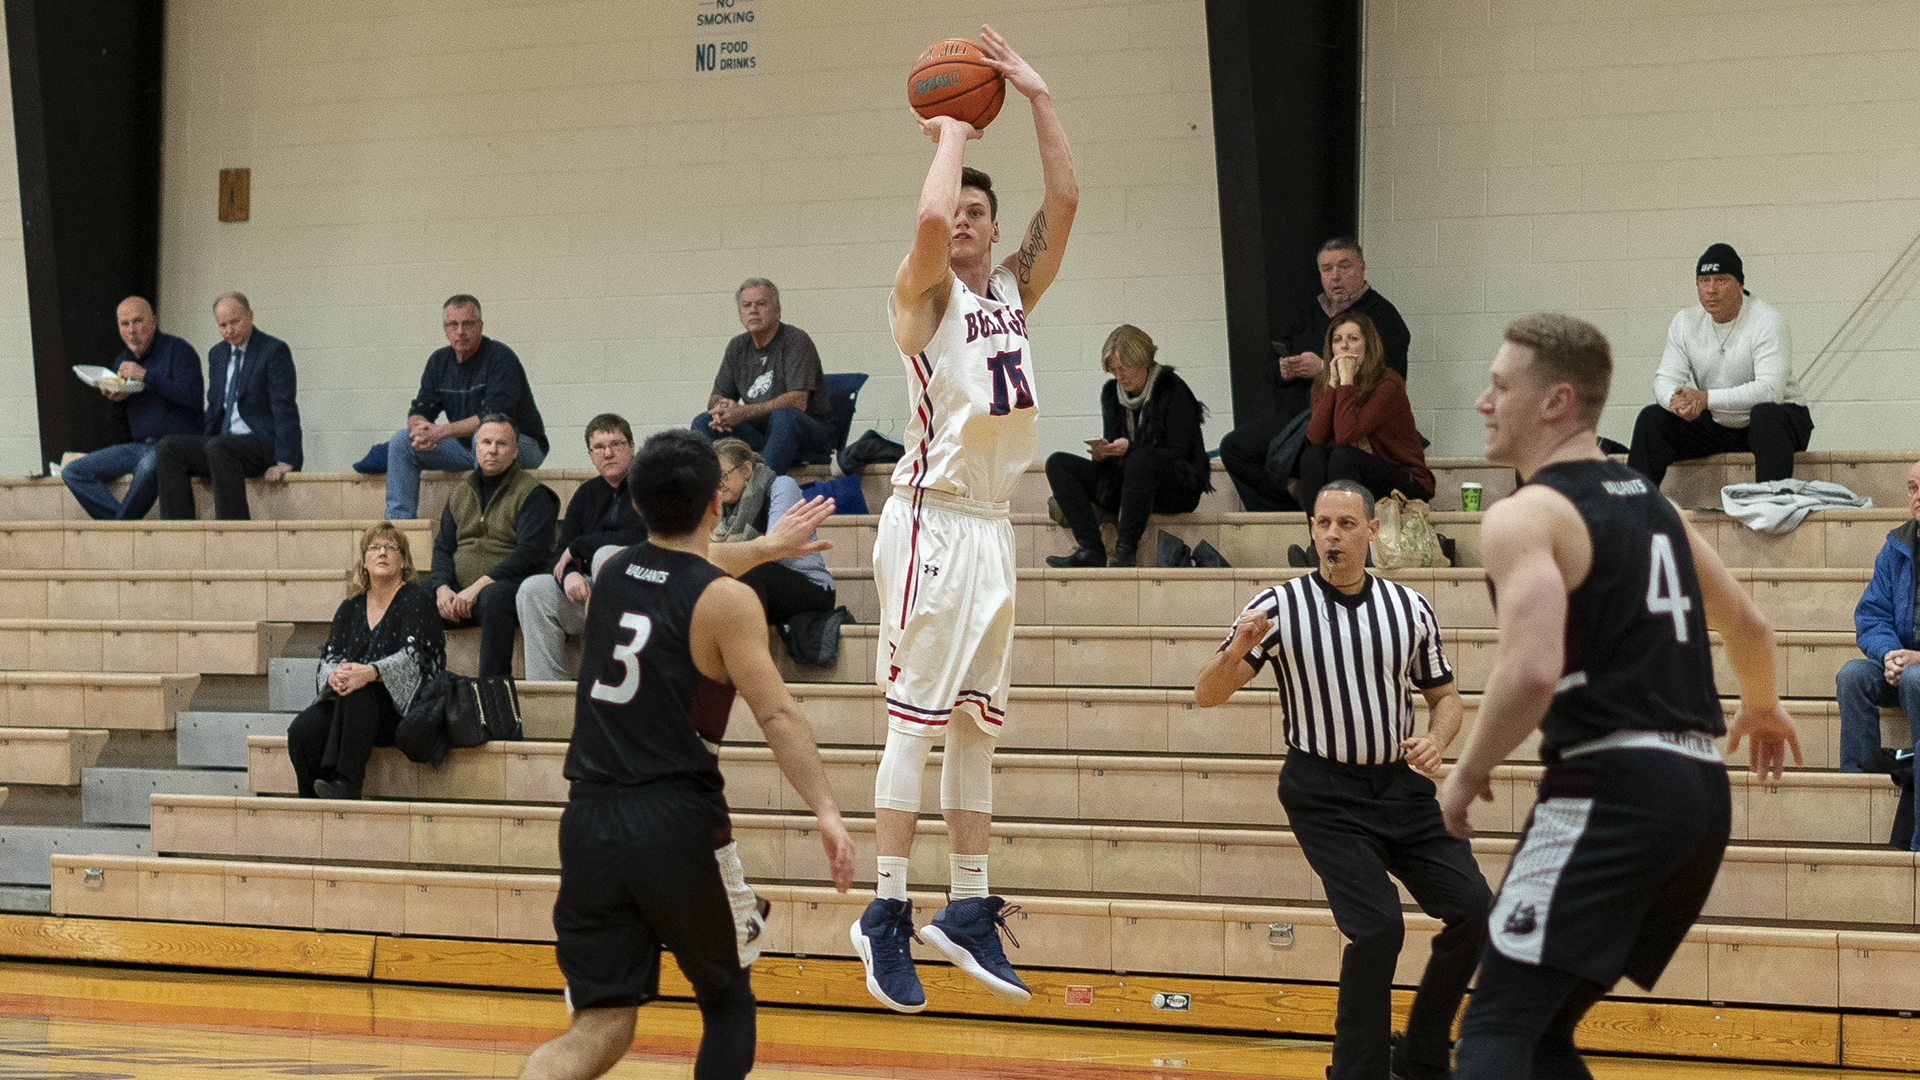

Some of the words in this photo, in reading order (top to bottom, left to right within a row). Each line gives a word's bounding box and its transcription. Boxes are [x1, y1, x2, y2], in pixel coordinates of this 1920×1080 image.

[716, 0, 735, 8] NO
[697, 10, 755, 26] SMOKING
[696, 43, 716, 72] NO
[720, 41, 748, 54] FOOD
[720, 56, 756, 70] DRINKS
[1700, 263, 1720, 273] UFC
[987, 348, 1034, 416] 15
[1601, 478, 1648, 496] VALIANTS
[625, 563, 670, 584] VALIANTS
[1646, 533, 1691, 644] 4
[590, 612, 652, 704] 3
